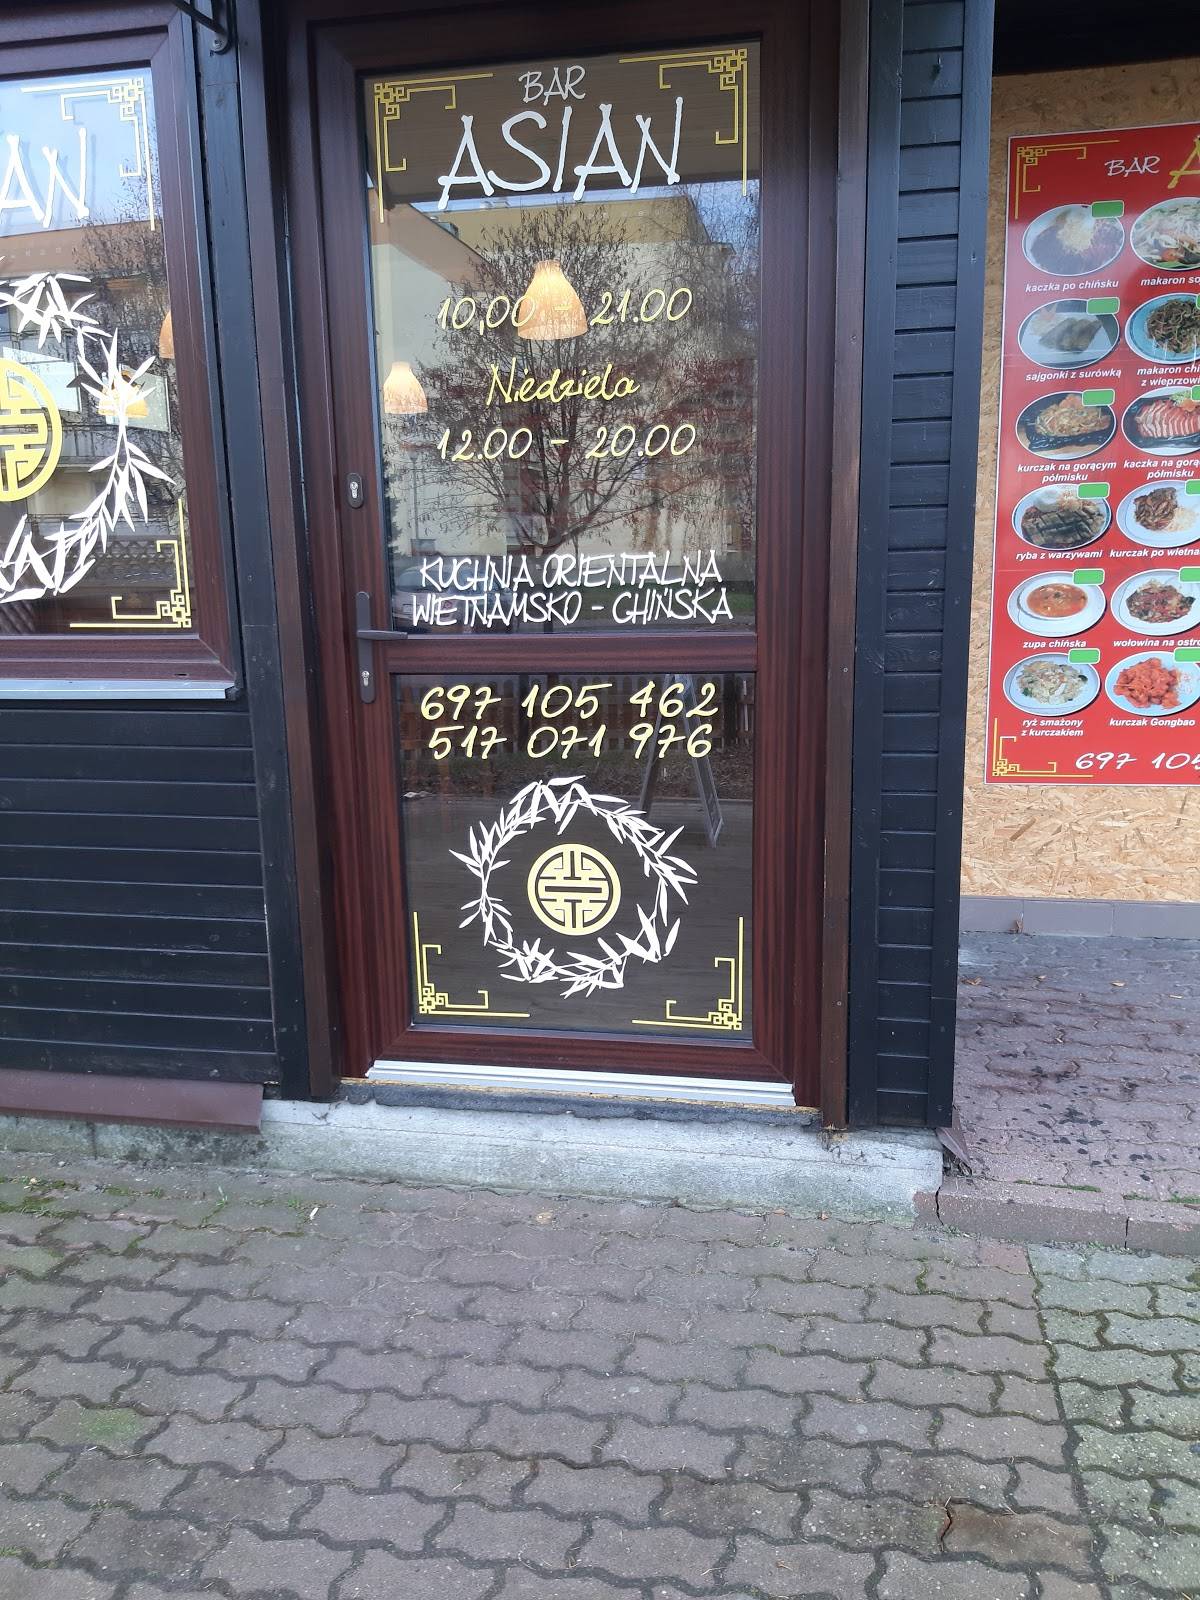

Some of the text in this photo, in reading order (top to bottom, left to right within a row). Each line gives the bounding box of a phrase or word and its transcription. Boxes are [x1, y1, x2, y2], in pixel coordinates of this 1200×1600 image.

[518, 64, 586, 105] BAR
[437, 96, 684, 210] ASIAN
[1105, 155, 1160, 177] BAR
[1025, 279, 1119, 292] kaczka po chińsku
[1141, 277, 1185, 287] makaron
[590, 287, 693, 326] 21.00
[1026, 371, 1069, 382] sajgonki
[1079, 368, 1121, 379] surówką
[1137, 365, 1181, 375] makaron
[486, 356, 641, 406] Niedziela
[1141, 379, 1147, 387] z
[437, 427, 533, 461] 12.00
[585, 424, 696, 459] 20.00
[1017, 460, 1117, 473] kurczak na gorącym
[1123, 459, 1158, 469] kaczka
[1161, 459, 1174, 467] na
[1042, 472, 1089, 484] półmisku
[1147, 467, 1194, 480] półmisku
[1016, 551, 1038, 561] ryba
[1048, 549, 1103, 560] warzywami
[1109, 548, 1148, 557] kurczak
[1151, 549, 1164, 558] po
[420, 550, 724, 592] KUCHNIA ORIENTALNA
[412, 591, 582, 629] WIETNAMSKO
[612, 587, 734, 624] CHIŃSKA
[1023, 639, 1087, 650] zupa chińska
[1113, 638, 1159, 647] wołowina
[1162, 639, 1175, 647] na
[421, 681, 719, 721] 697 105 462
[1022, 718, 1084, 728] ryż smażony
[1109, 717, 1196, 728] kurczak Gongbao
[1021, 728, 1084, 737] z kurczakiem
[428, 723, 713, 760] 517 071 976
[1075, 751, 1138, 770] 697
